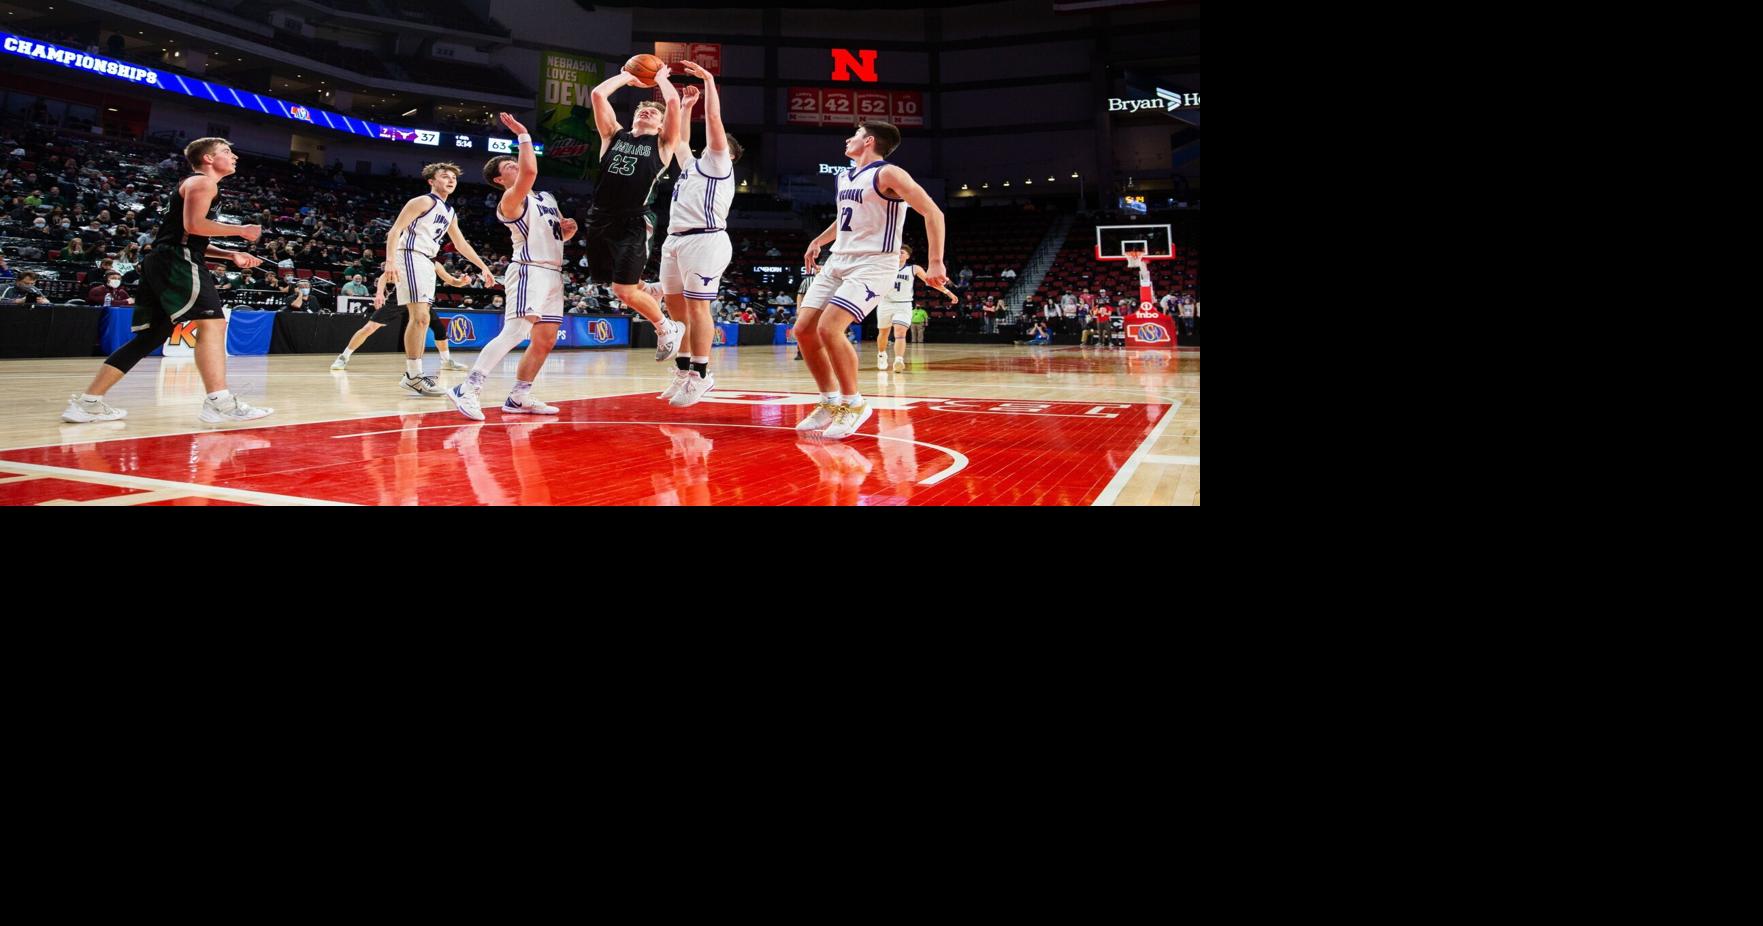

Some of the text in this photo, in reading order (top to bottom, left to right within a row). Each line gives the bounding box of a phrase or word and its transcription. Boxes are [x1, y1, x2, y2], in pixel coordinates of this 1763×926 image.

[3, 37, 158, 84] CHAMPIONSHIPS
[547, 55, 597, 73] NEBRASKA
[832, 49, 877, 81] N
[546, 68, 577, 81] LOVES
[791, 98, 816, 111] 22
[825, 99, 849, 112] 42
[861, 101, 885, 113] 52
[897, 101, 917, 114] 10
[1108, 98, 1164, 113] Bryan
[421, 133, 435, 142] 37
[492, 141, 506, 150] 63
[608, 153, 638, 176] 23
[819, 164, 853, 175] Brya
[1136, 310, 1159, 318] fnbo
